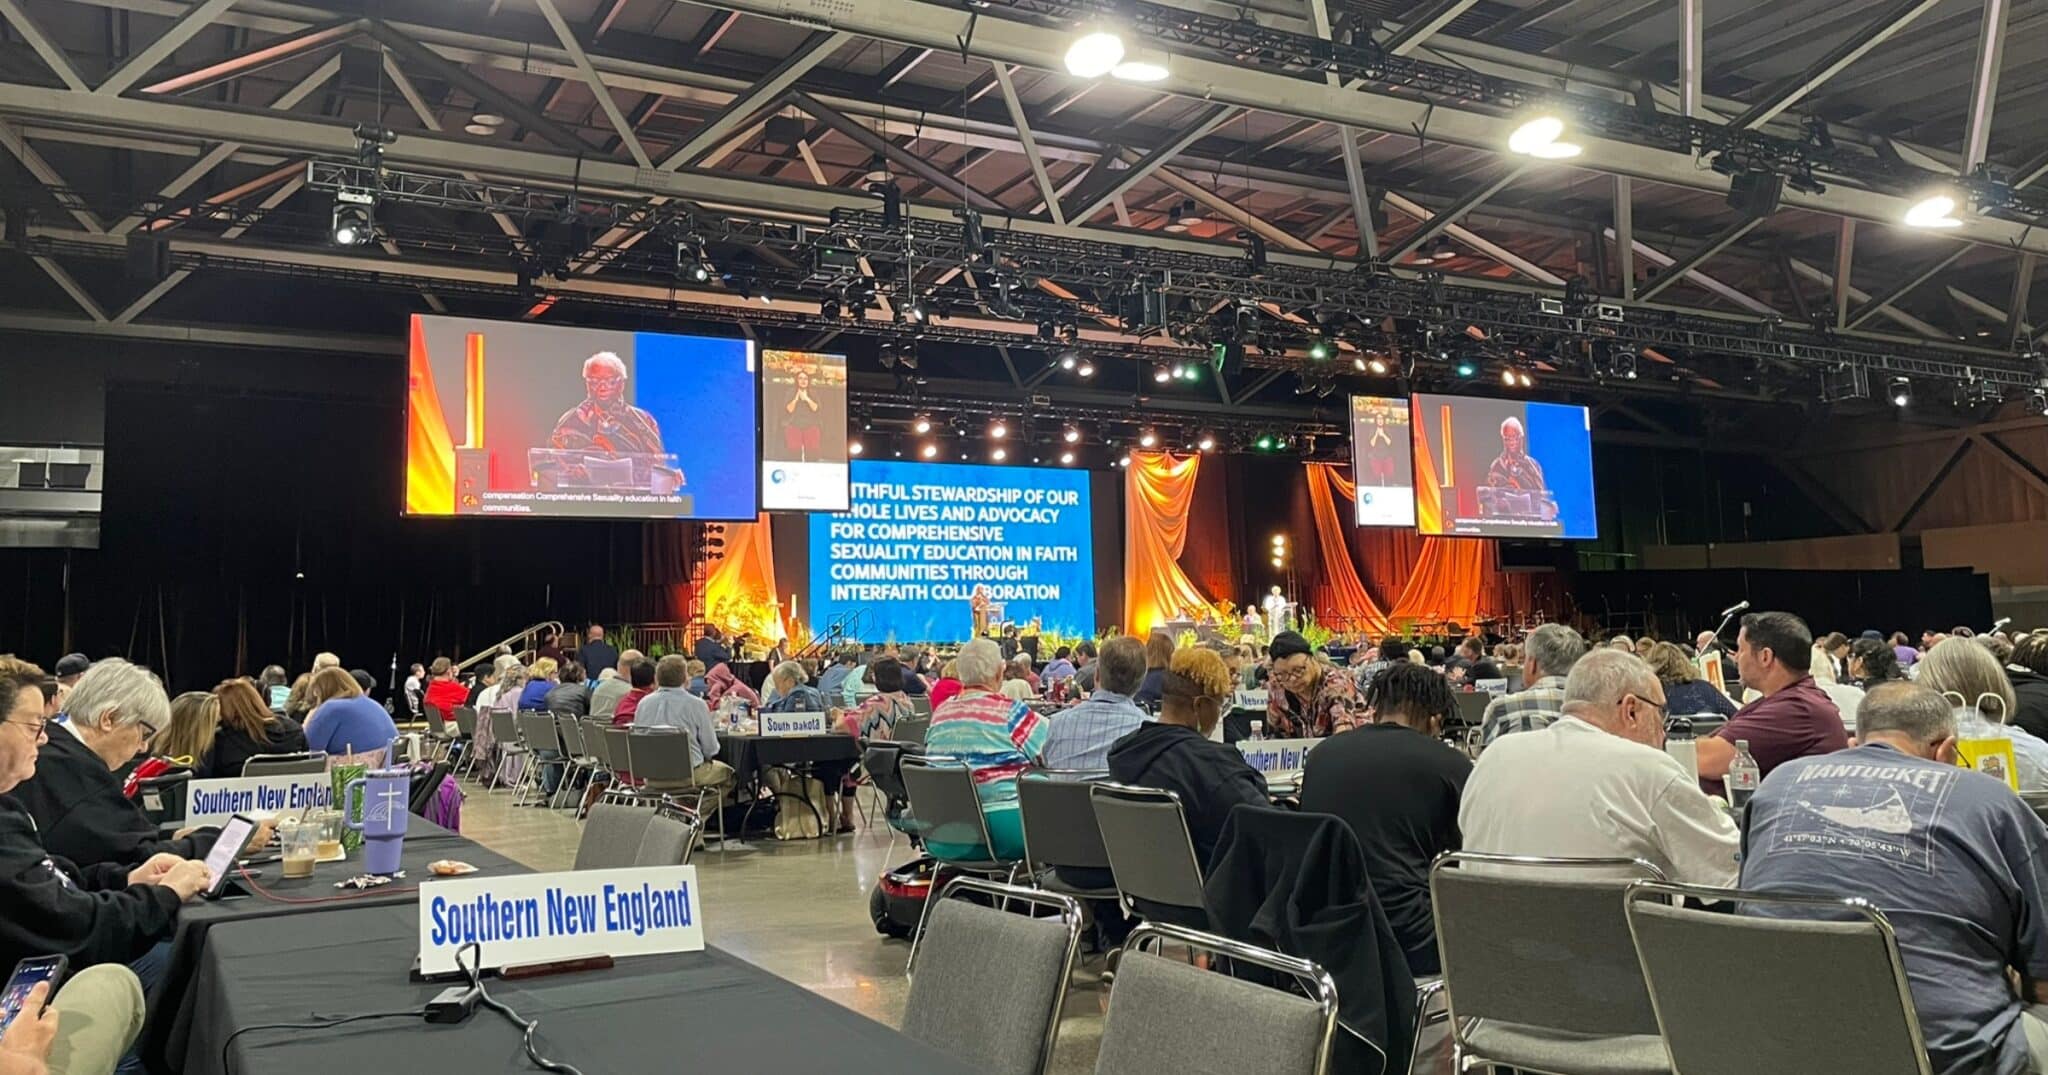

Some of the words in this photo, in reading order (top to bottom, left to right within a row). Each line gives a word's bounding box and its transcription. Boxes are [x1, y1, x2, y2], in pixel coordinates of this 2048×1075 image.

[536, 492, 591, 502] Comprehensive
[592, 493, 623, 503] Sexuality
[851, 482, 910, 500] ITHFUL
[911, 485, 1022, 503] STEWARDSHIP
[1023, 488, 1045, 504] OF
[1046, 489, 1079, 505] OUR
[832, 503, 891, 519] HOLE
[894, 503, 939, 520] LIVES
[940, 505, 976, 521] AND
[977, 506, 1060, 524] ADVOCACY
[831, 522, 866, 539] FOR
[867, 523, 1005, 541] COMPREHENSIVE
[830, 543, 921, 560] SEXUALITY
[923, 544, 1013, 561] EDUCATION
[1016, 545, 1032, 561] IN
[1035, 546, 1077, 561] FAITH
[830, 563, 949, 580] COMMUNITIES
[950, 564, 1028, 581] THROUGH
[831, 584, 929, 601] INTERFAITH
[767, 717, 791, 732] South
[793, 717, 820, 731] Dakota
[1280, 747, 1300, 771] New
[1795, 764, 1947, 794] NANTUCKET
[193, 787, 253, 815] Southern
[257, 785, 287, 811] New
[290, 782, 332, 809] Englan
[431, 893, 540, 946] Southern
[546, 888, 597, 936] New
[603, 881, 692, 937] England
